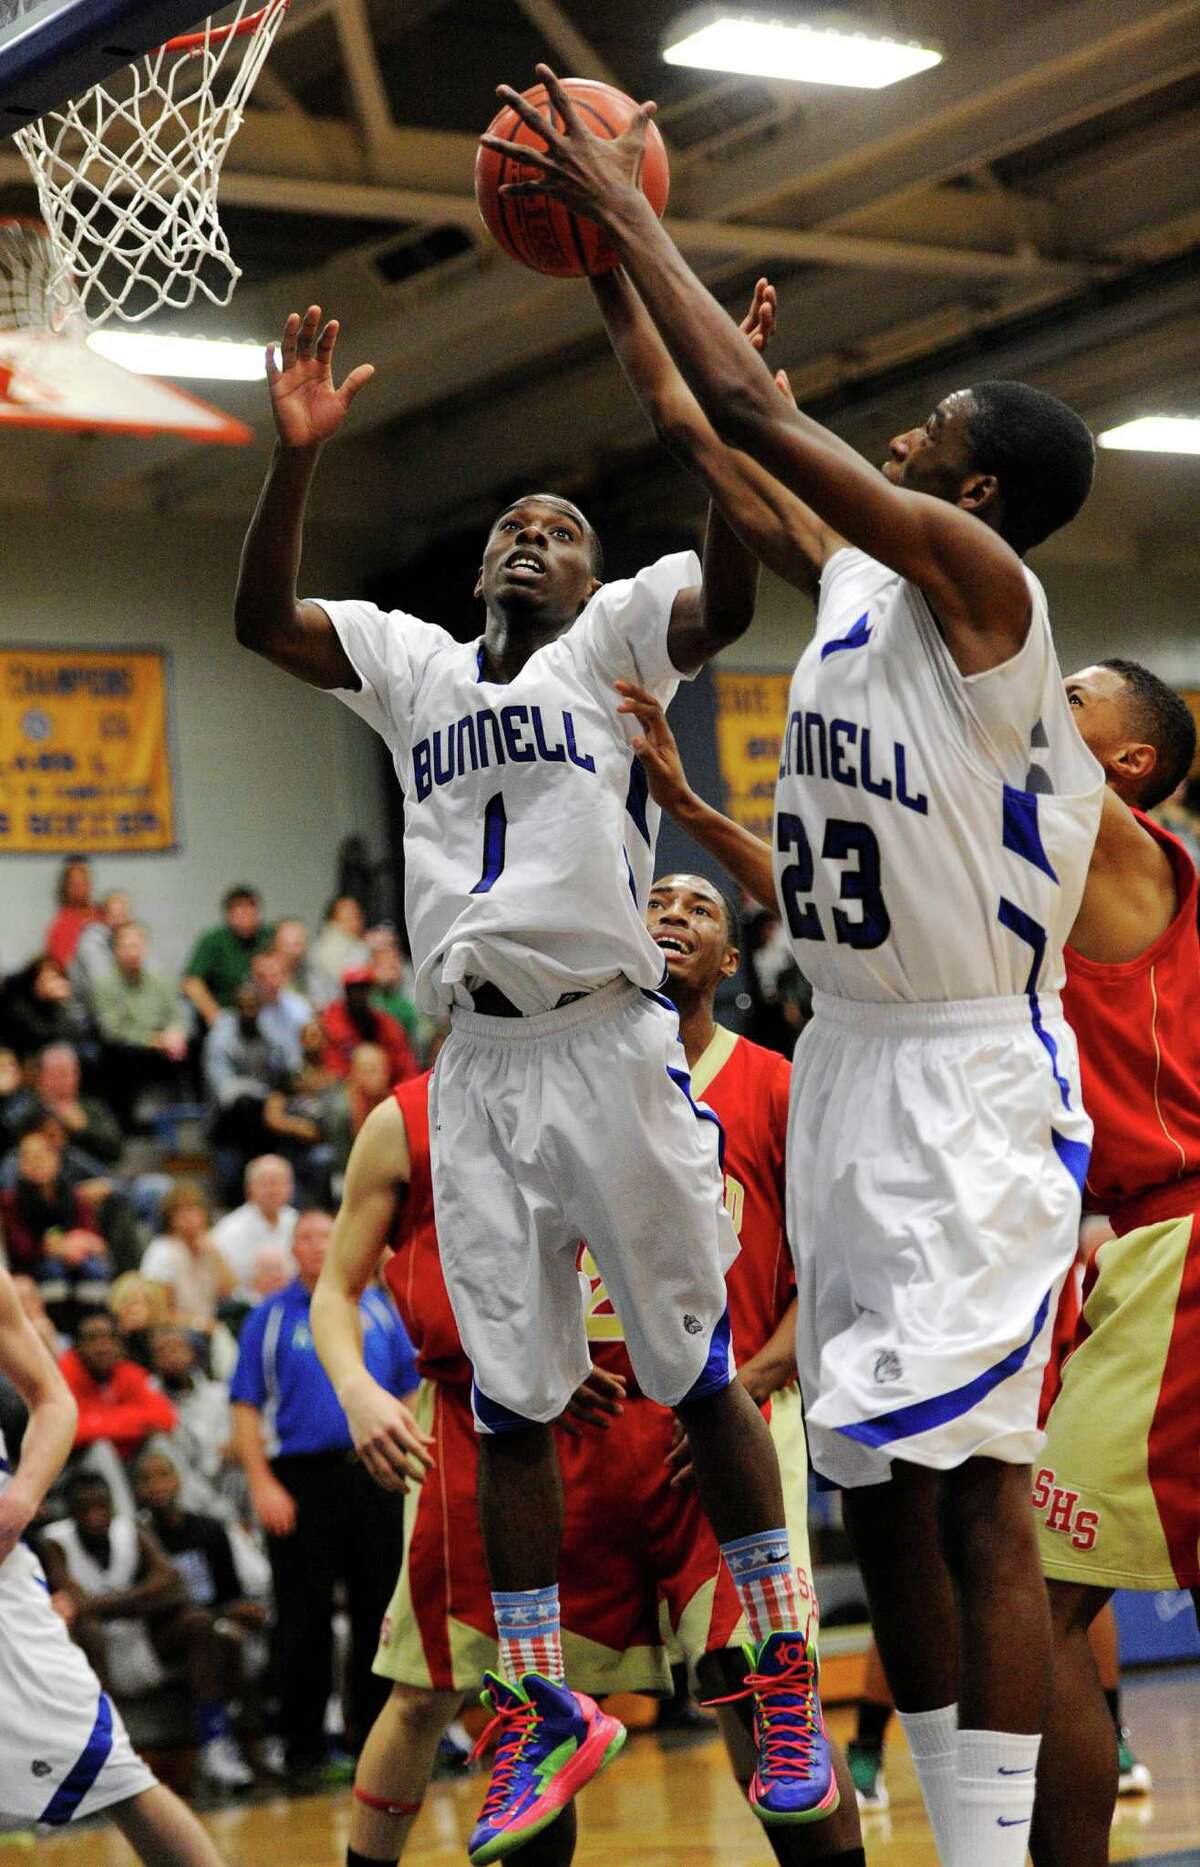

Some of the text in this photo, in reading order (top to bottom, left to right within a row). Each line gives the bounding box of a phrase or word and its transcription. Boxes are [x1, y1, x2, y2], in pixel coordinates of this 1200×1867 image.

[411, 705, 596, 804] BUNNELL
[779, 710, 928, 816] NNELL
[469, 791, 507, 894] 1
[777, 811, 891, 950] 23
[1031, 1468, 1099, 1551] SHS
